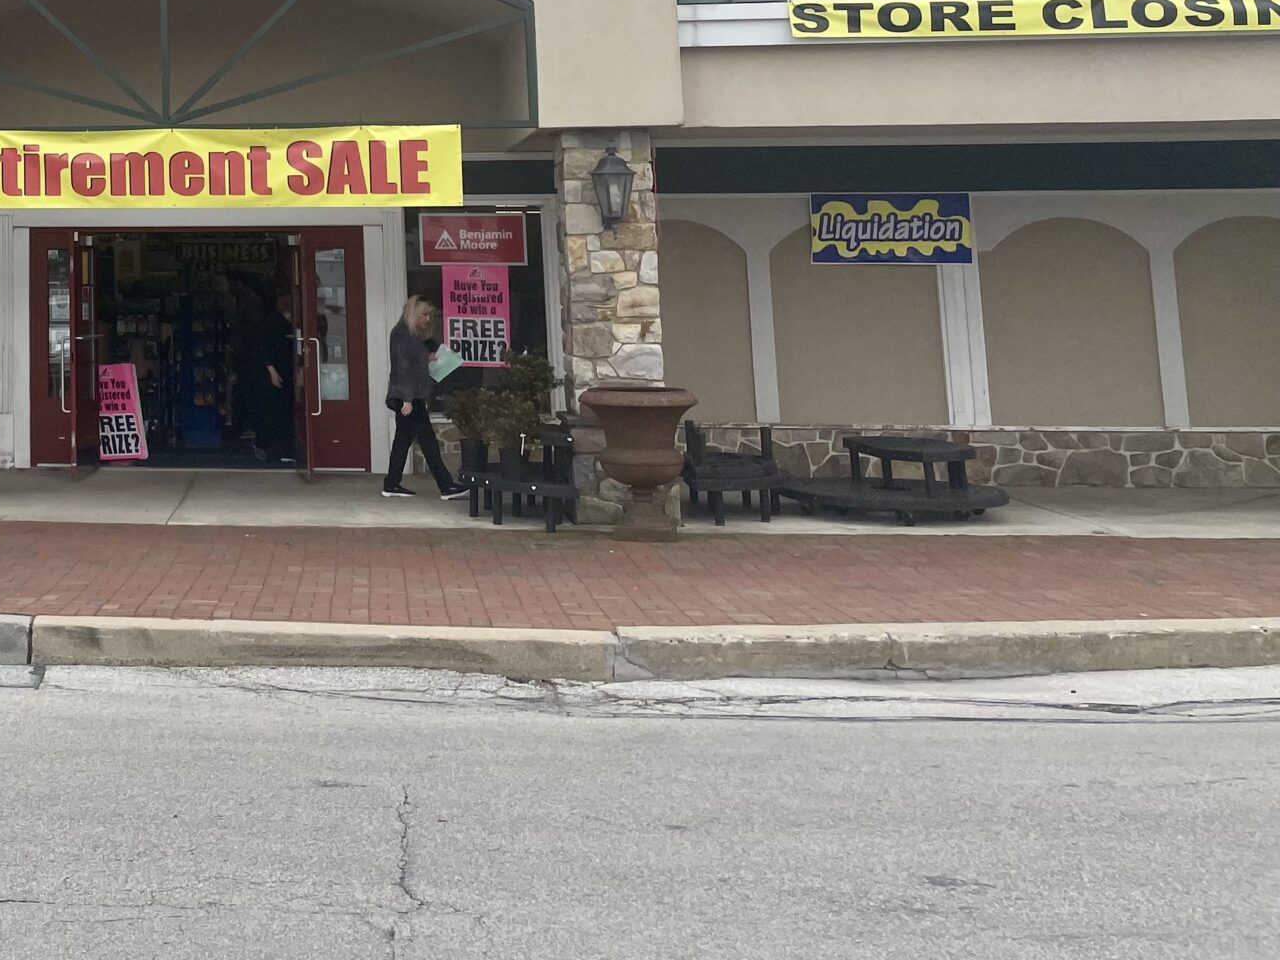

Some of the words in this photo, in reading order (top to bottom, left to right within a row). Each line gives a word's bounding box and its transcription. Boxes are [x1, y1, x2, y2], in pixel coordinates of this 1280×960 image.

[792, 0, 1017, 33] STORE
[286, 139, 431, 195] SALE
[459, 229, 513, 240] Benjamin
[820, 213, 962, 250] Liquidation
[459, 241, 498, 250] Moore
[453, 280, 477, 291] Have
[480, 280, 499, 291] You
[450, 292, 503, 305] Registered
[457, 304, 467, 314] to
[470, 304, 487, 315] win
[490, 306, 497, 315] a
[449, 319, 505, 338] FREE
[111, 379, 126, 389] You
[105, 402, 119, 411] win
[99, 415, 136, 433] REE
[100, 433, 140, 454] RIZE?
